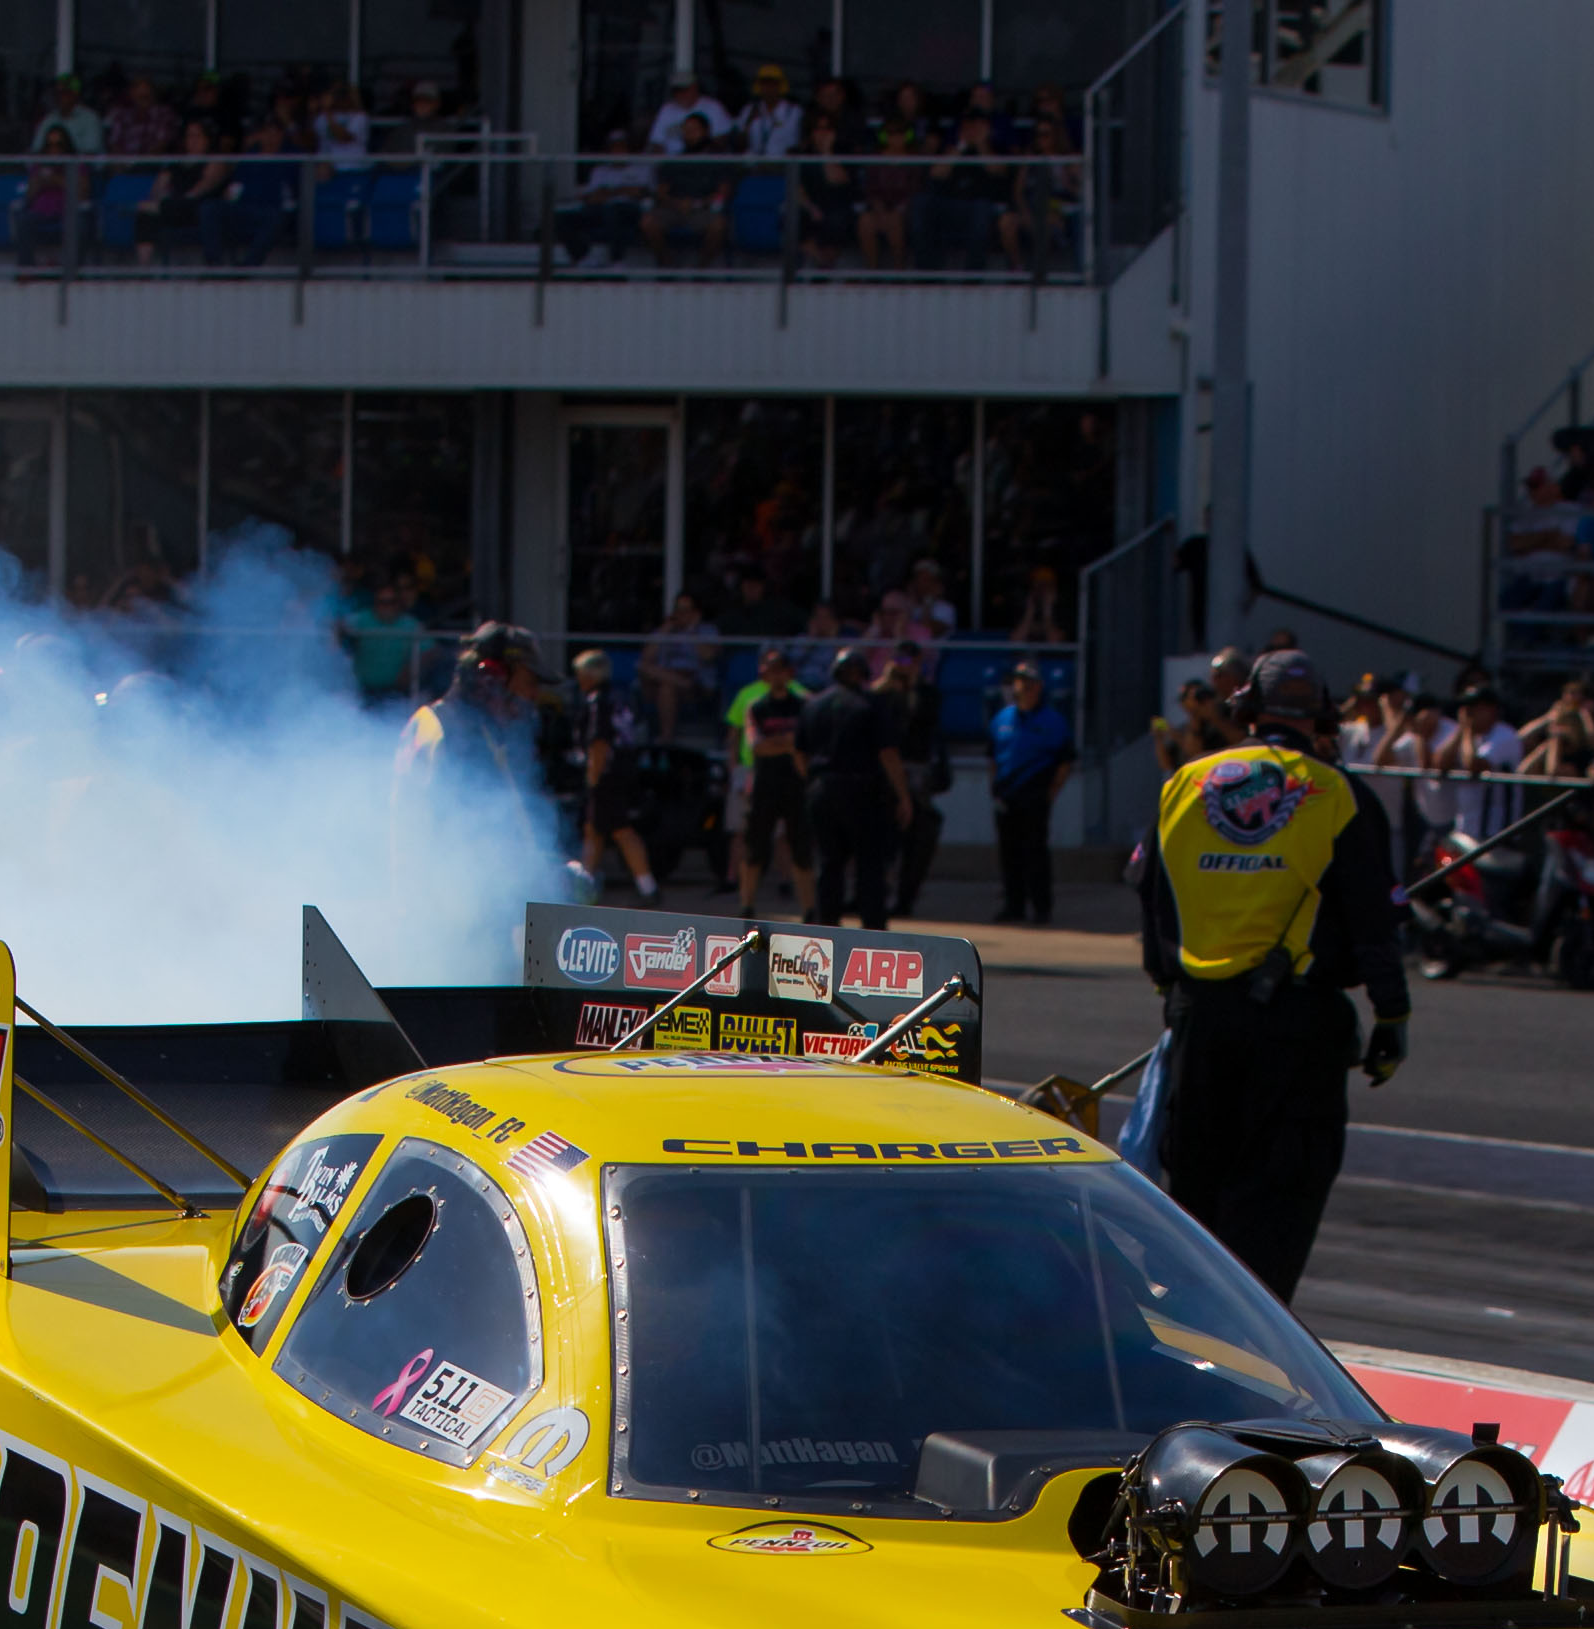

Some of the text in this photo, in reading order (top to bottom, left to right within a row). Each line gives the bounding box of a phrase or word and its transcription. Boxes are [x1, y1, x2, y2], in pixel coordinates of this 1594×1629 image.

[558, 928, 619, 975] CLEVITE
[842, 949, 922, 990] ARP
[722, 1014, 794, 1055] BULLET
[662, 1136, 1086, 1160] CHARGER
[421, 1367, 479, 1413] 5.11
[408, 1400, 473, 1441] TACTICAL
[484, 1461, 549, 1495] MOPAR
[729, 1537, 851, 1550] PENNZOIL
